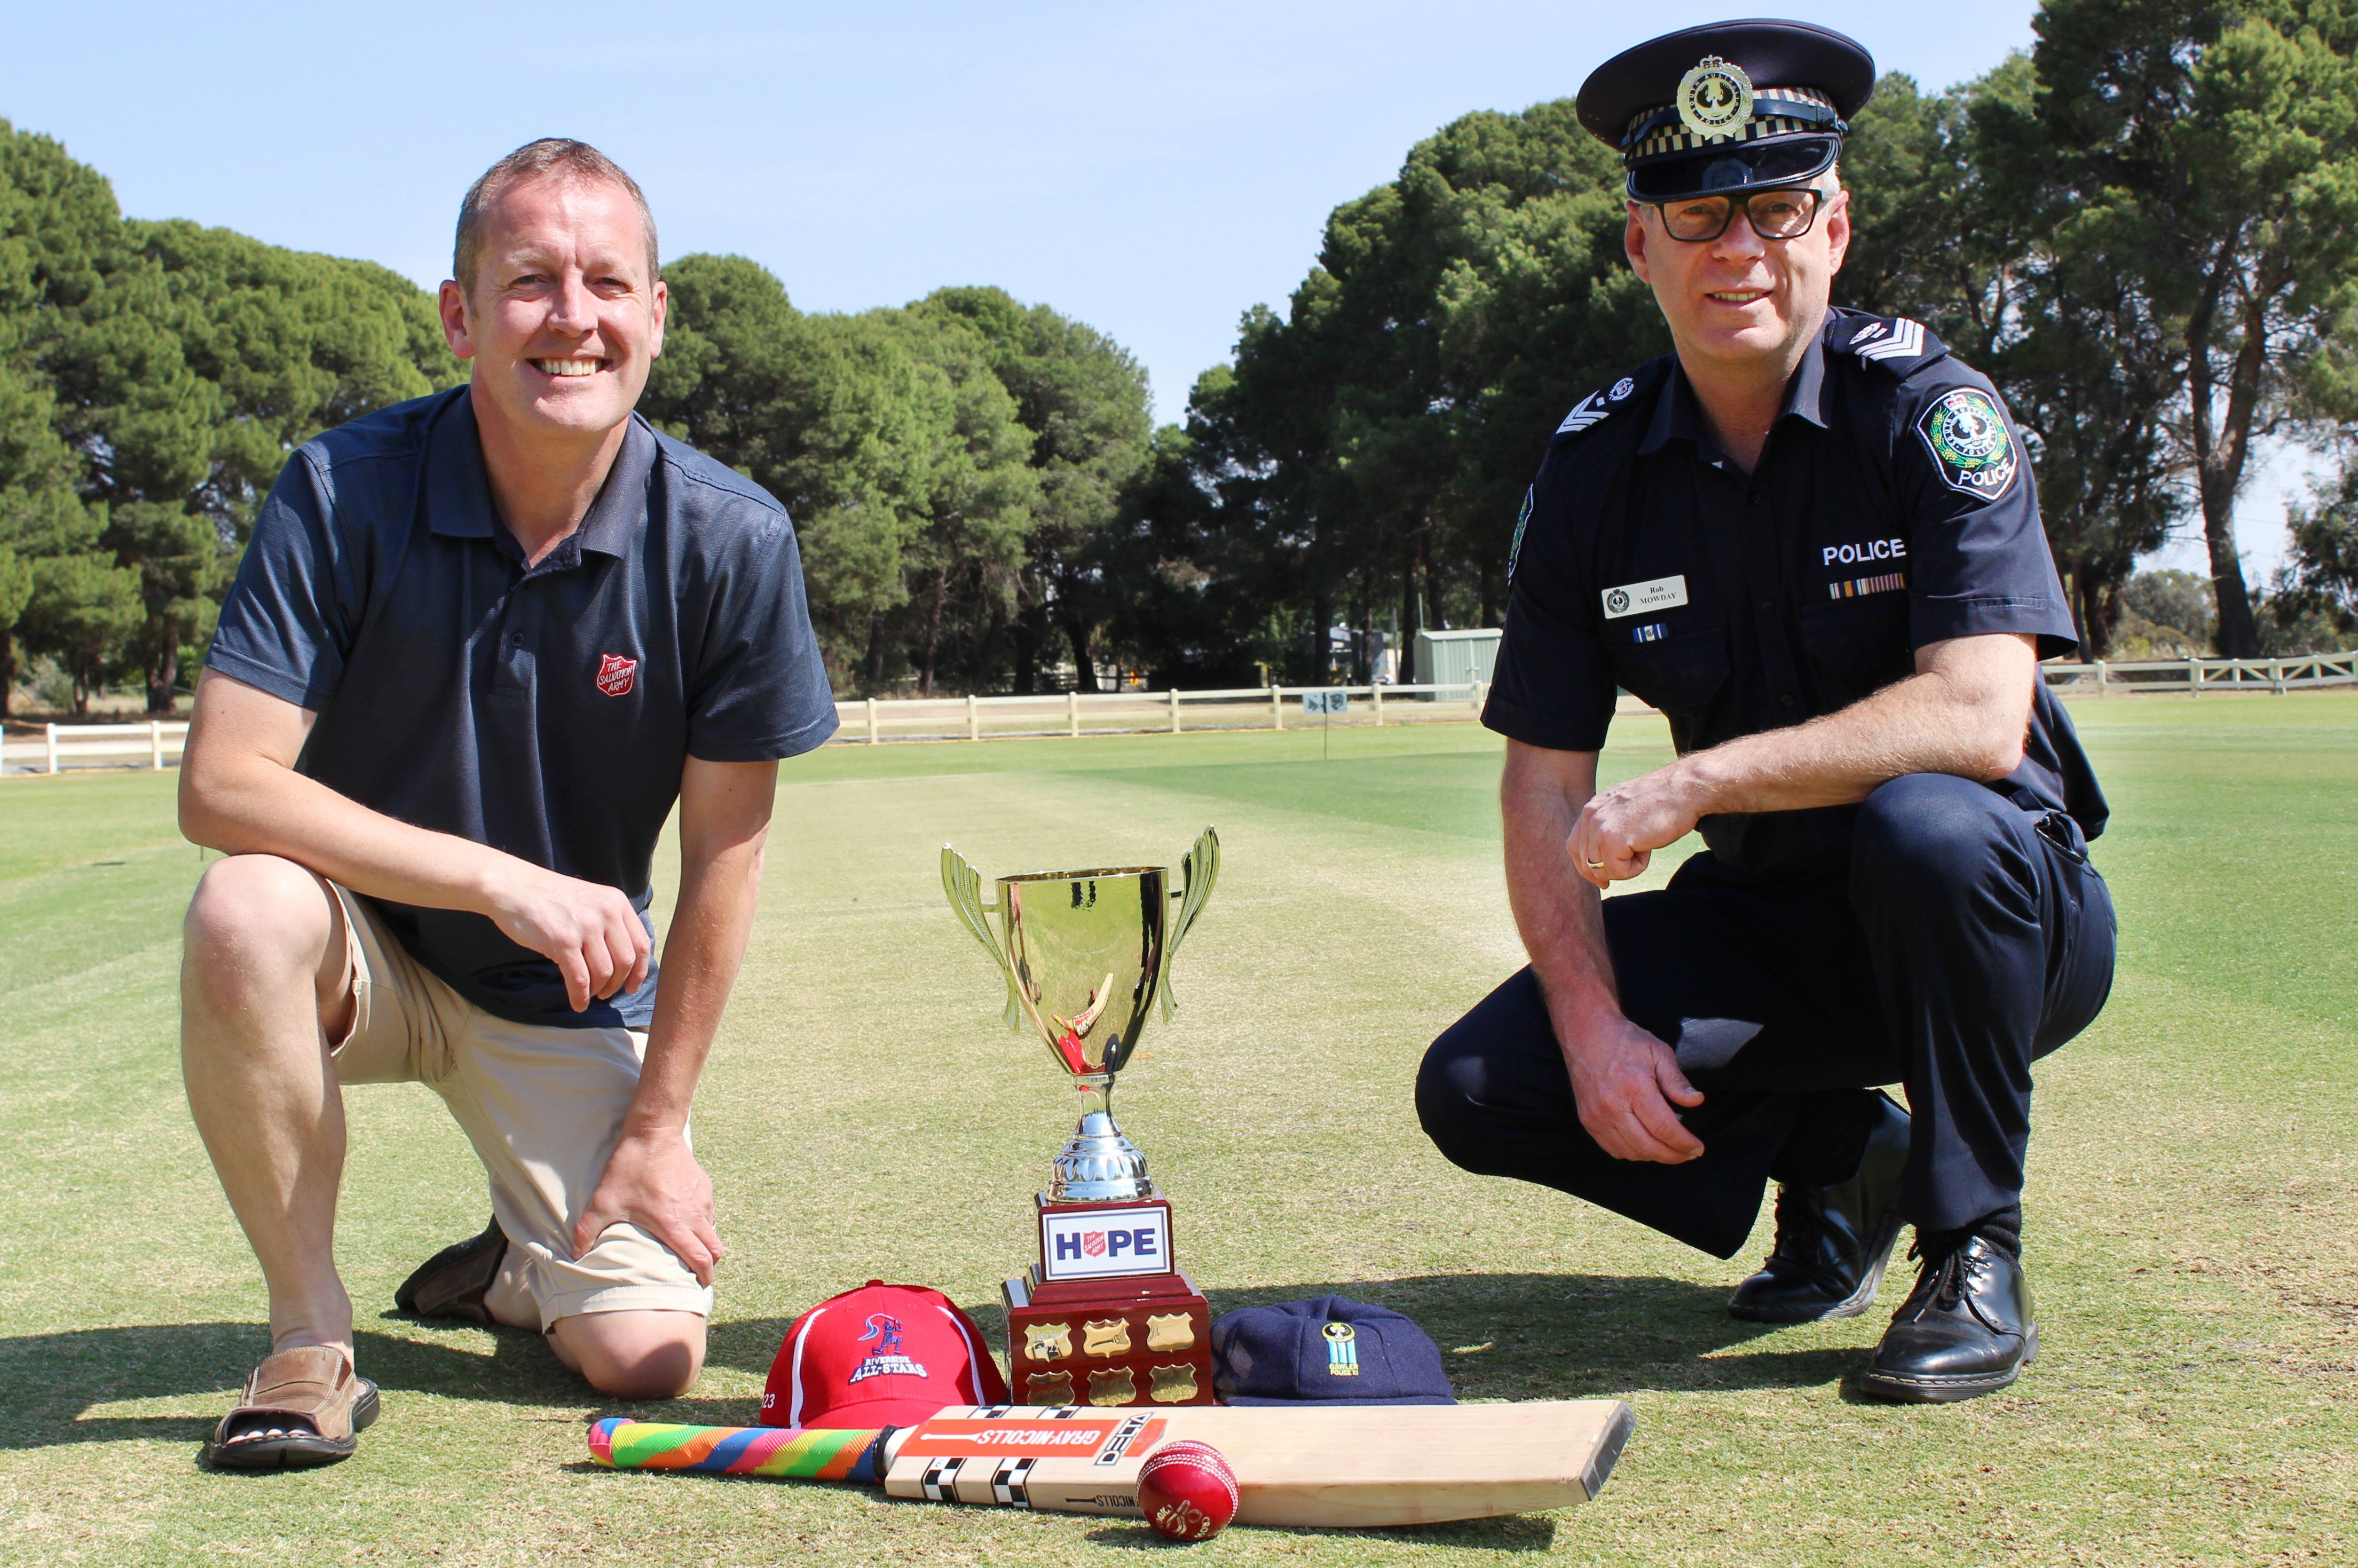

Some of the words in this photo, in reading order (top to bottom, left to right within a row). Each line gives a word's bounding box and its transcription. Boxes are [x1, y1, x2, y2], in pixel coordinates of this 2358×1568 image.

[1689, 82, 1700, 113] SOUTH
[1700, 114, 1734, 125] POLICE
[1958, 457, 2012, 486] POLICE
[1823, 538, 1906, 566] POLICE
[1650, 586, 1663, 594] Rob
[1640, 592, 1676, 605] MOWDAY
[607, 660, 622, 672] THE
[598, 666, 633, 685] SALVATION
[608, 677, 629, 692] ARMY
[1084, 1234, 1104, 1252] SALVATION
[1086, 1233, 1096, 1242] THE
[1092, 1242, 1104, 1255] ARMY
[865, 1356, 911, 1366] RIVERSIDE
[850, 1363, 928, 1383] ALL-STARS
[761, 1393, 776, 1408] 23
[977, 1430, 1101, 1445] GRAY-NICOLLS
[1095, 1412, 1154, 1465] DELTA
[1096, 1495, 1139, 1507] NICOLLS
